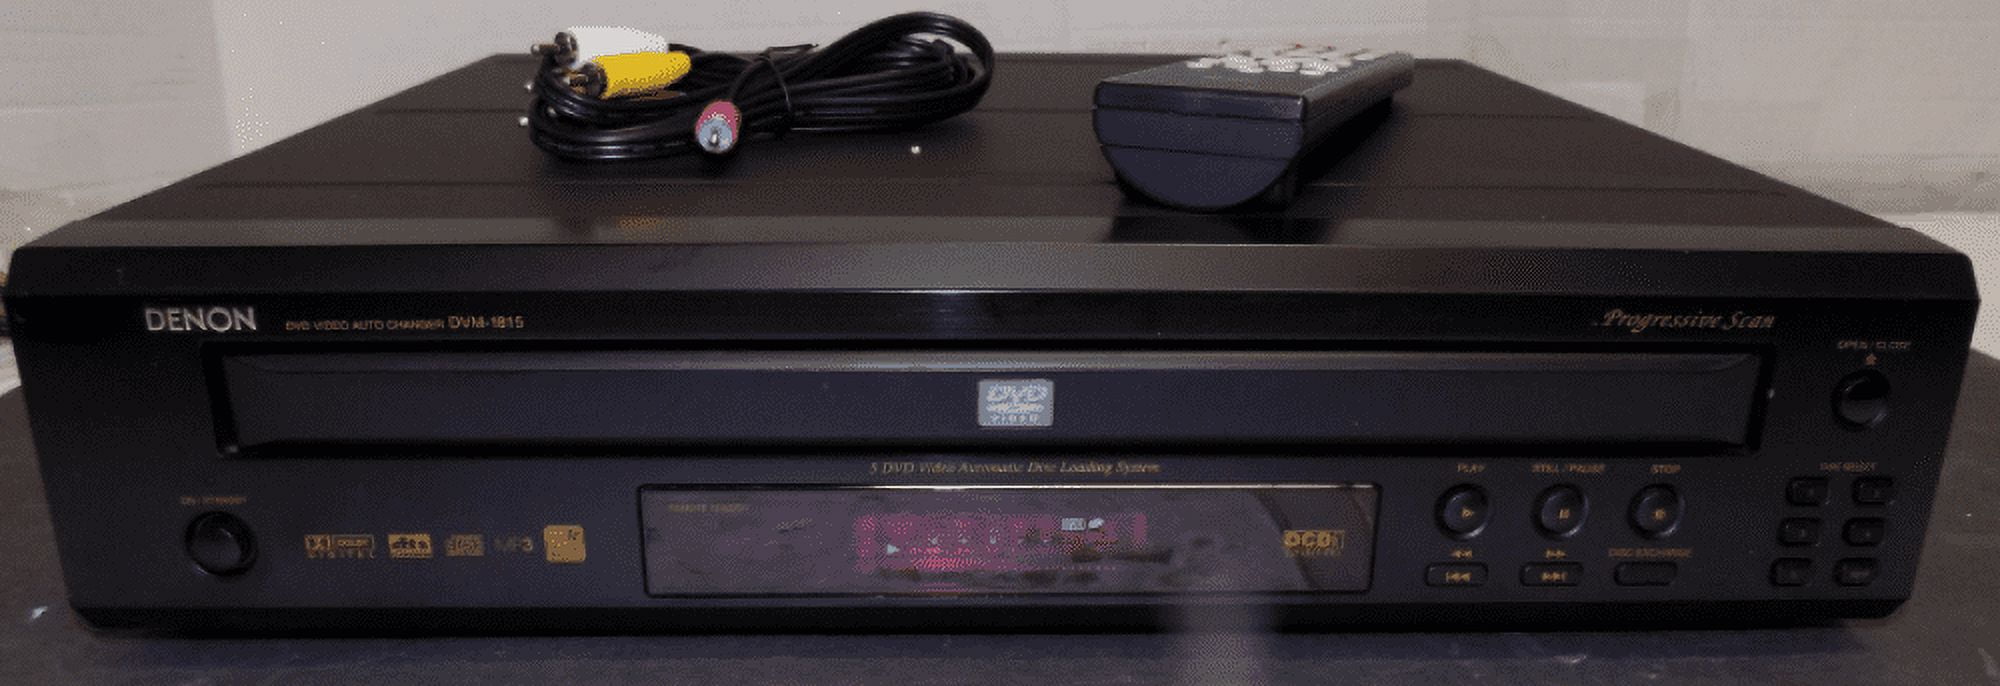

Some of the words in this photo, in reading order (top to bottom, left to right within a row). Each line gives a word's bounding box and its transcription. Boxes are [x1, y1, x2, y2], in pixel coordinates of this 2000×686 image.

[144, 306, 257, 332] DENON
[313, 320, 349, 331] VIDEO
[352, 320, 385, 331] AUTO
[386, 319, 445, 330] CHANGER
[1723, 311, 1775, 331] Scan
[986, 383, 1049, 402] DVD
[881, 462, 915, 474] DVD
[919, 461, 956, 474] Video
[957, 461, 1021, 474] Automatic
[1060, 461, 1112, 476] Loading
[1115, 461, 1161, 475] System
[1456, 463, 1486, 474] PLAY
[1651, 463, 1681, 474] STOP
